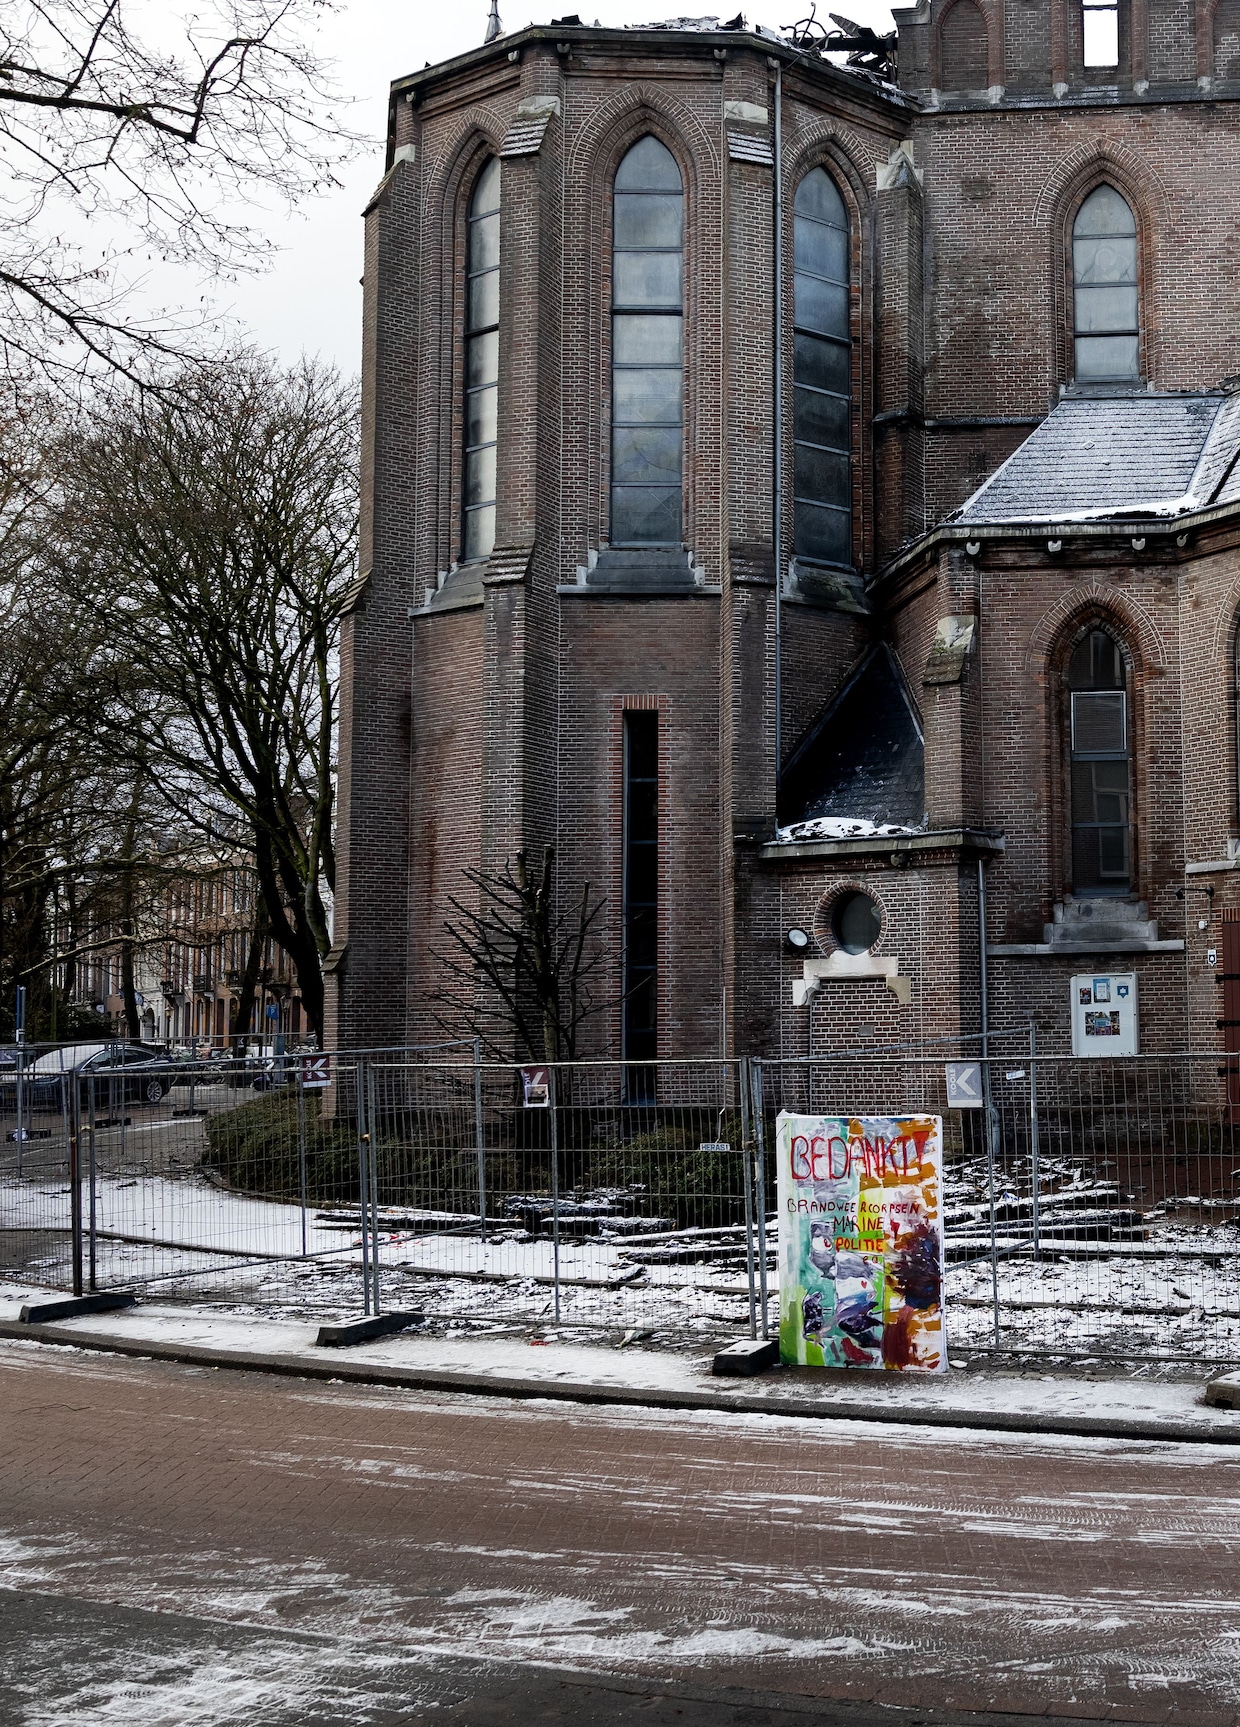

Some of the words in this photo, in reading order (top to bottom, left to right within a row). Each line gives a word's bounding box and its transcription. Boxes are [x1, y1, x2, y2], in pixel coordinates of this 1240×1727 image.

[949, 1068, 957, 1096] KOOLE
[790, 1131, 930, 1181] BEDANKT!
[832, 1215, 884, 1233] MARINE
[835, 1236, 884, 1253] POLITIE
